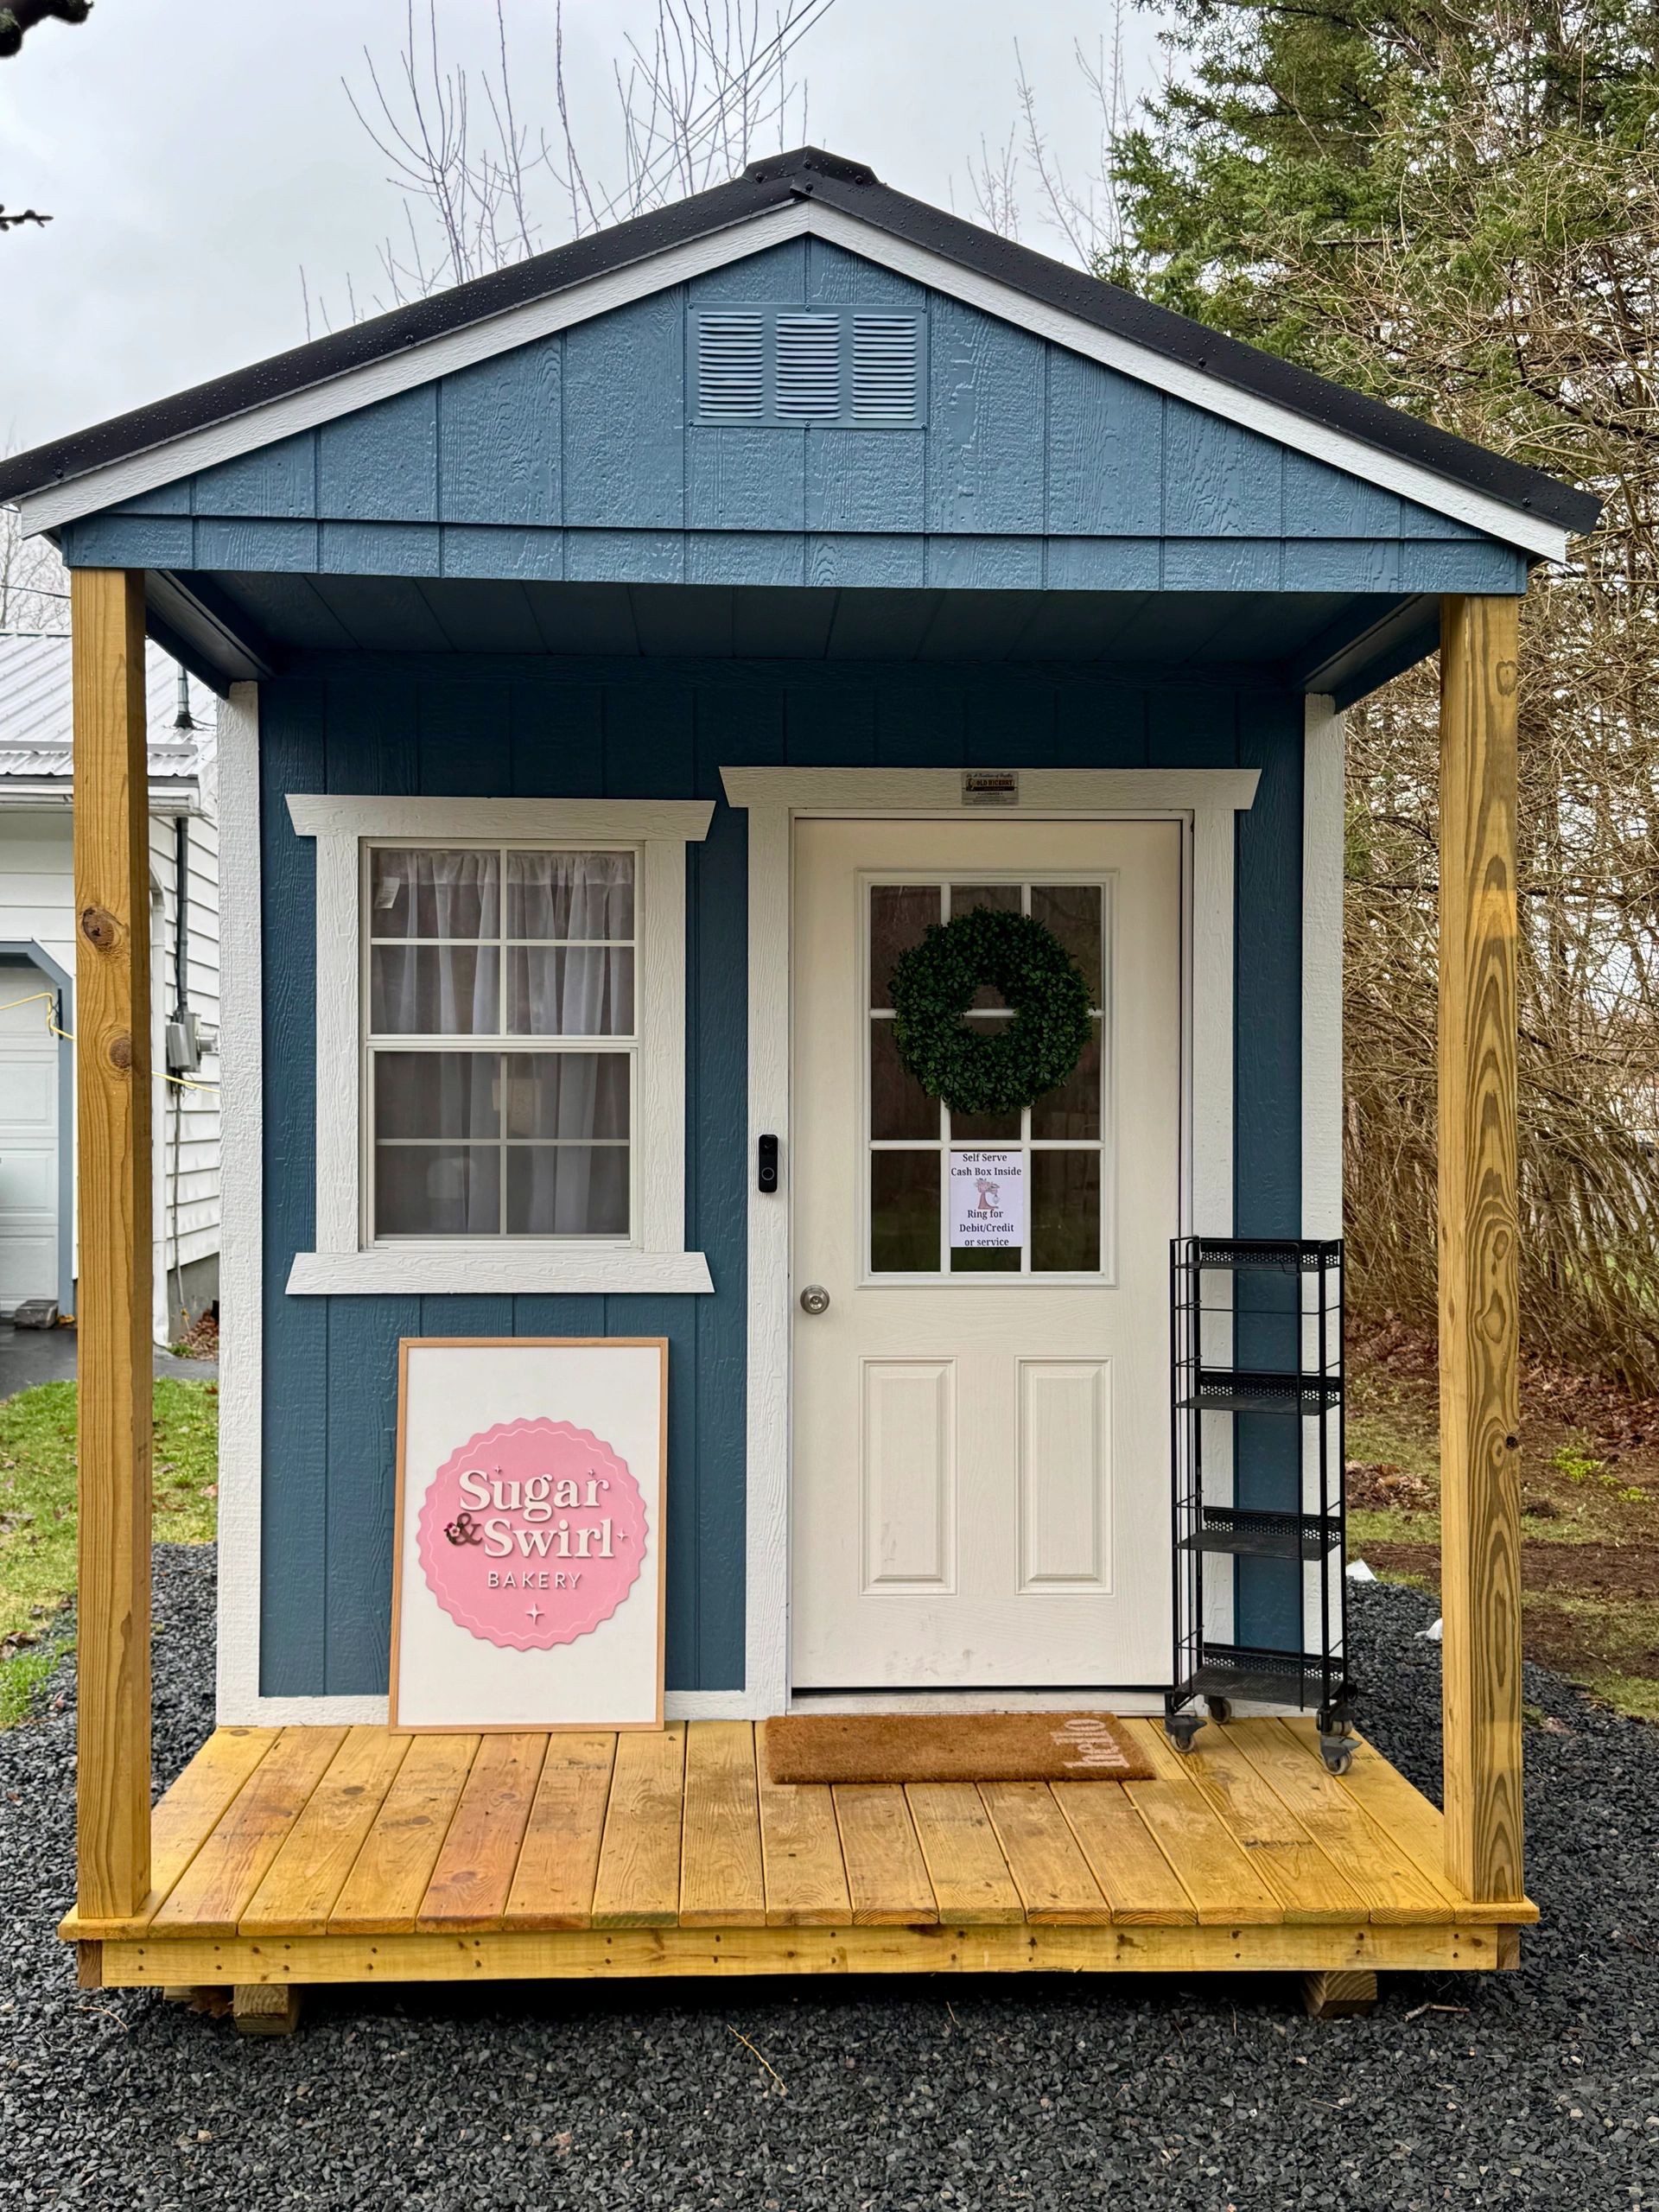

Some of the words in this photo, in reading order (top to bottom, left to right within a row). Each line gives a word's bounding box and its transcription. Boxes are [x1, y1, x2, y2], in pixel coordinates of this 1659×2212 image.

[963, 1154, 981, 1162] Self
[982, 1154, 1007, 1162] Serve
[950, 1167, 972, 1176] Cash
[975, 1167, 992, 1176] Box
[994, 1166, 1022, 1176] Inside
[967, 1210, 988, 1220] Ring
[989, 1210, 1004, 1218] for
[959, 1224, 1014, 1233] Debit/Credit
[976, 1237, 1009, 1246] service
[458, 1470, 610, 1522] Sugar
[483, 1517, 615, 1558] Swirl
[486, 1571, 582, 1590] BAKERY
[1049, 1719, 1130, 1769] hello
